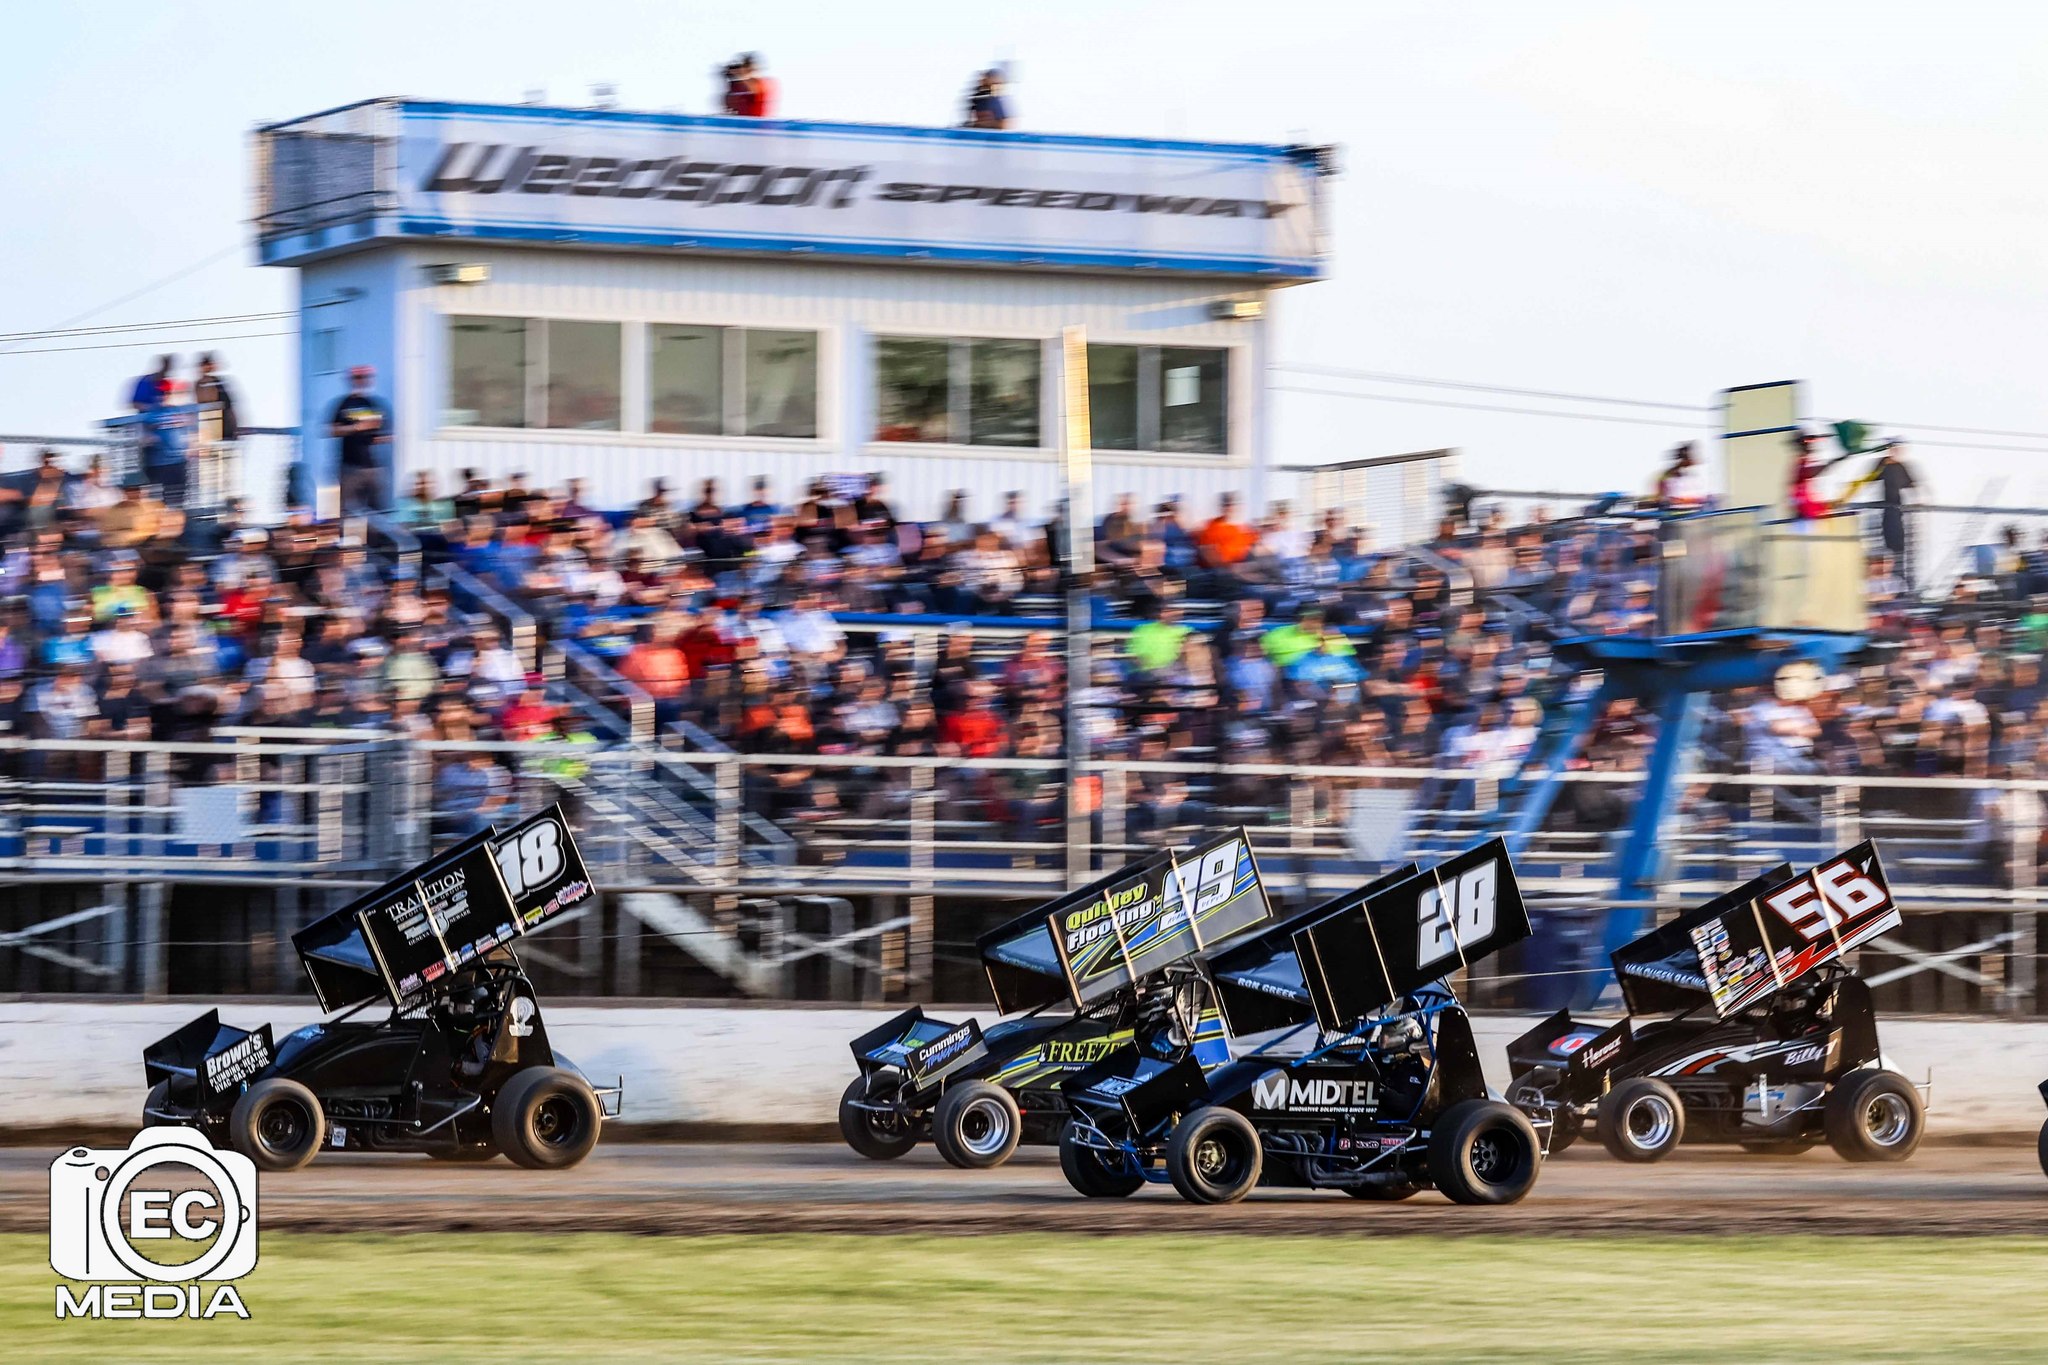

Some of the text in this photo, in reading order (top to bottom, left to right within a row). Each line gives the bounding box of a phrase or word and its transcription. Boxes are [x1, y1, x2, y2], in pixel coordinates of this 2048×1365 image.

[425, 143, 1301, 220] Weedsport SPEEDWAY
[495, 819, 565, 900] 18
[1159, 837, 1242, 932] 99
[1764, 859, 1888, 941] 56
[1067, 901, 1155, 953] Flooing
[1417, 857, 1498, 970] 28
[1237, 977, 1297, 999] RON GREEK
[206, 1033, 263, 1079] Brown's
[919, 1026, 970, 1062] Cummings
[1784, 1045, 1824, 1066] Billy
[209, 1047, 269, 1088] PLUMBING HEATING
[214, 1057, 270, 1093] HVAC GAS LP OIL
[1289, 1079, 1379, 1105] MIDTEL
